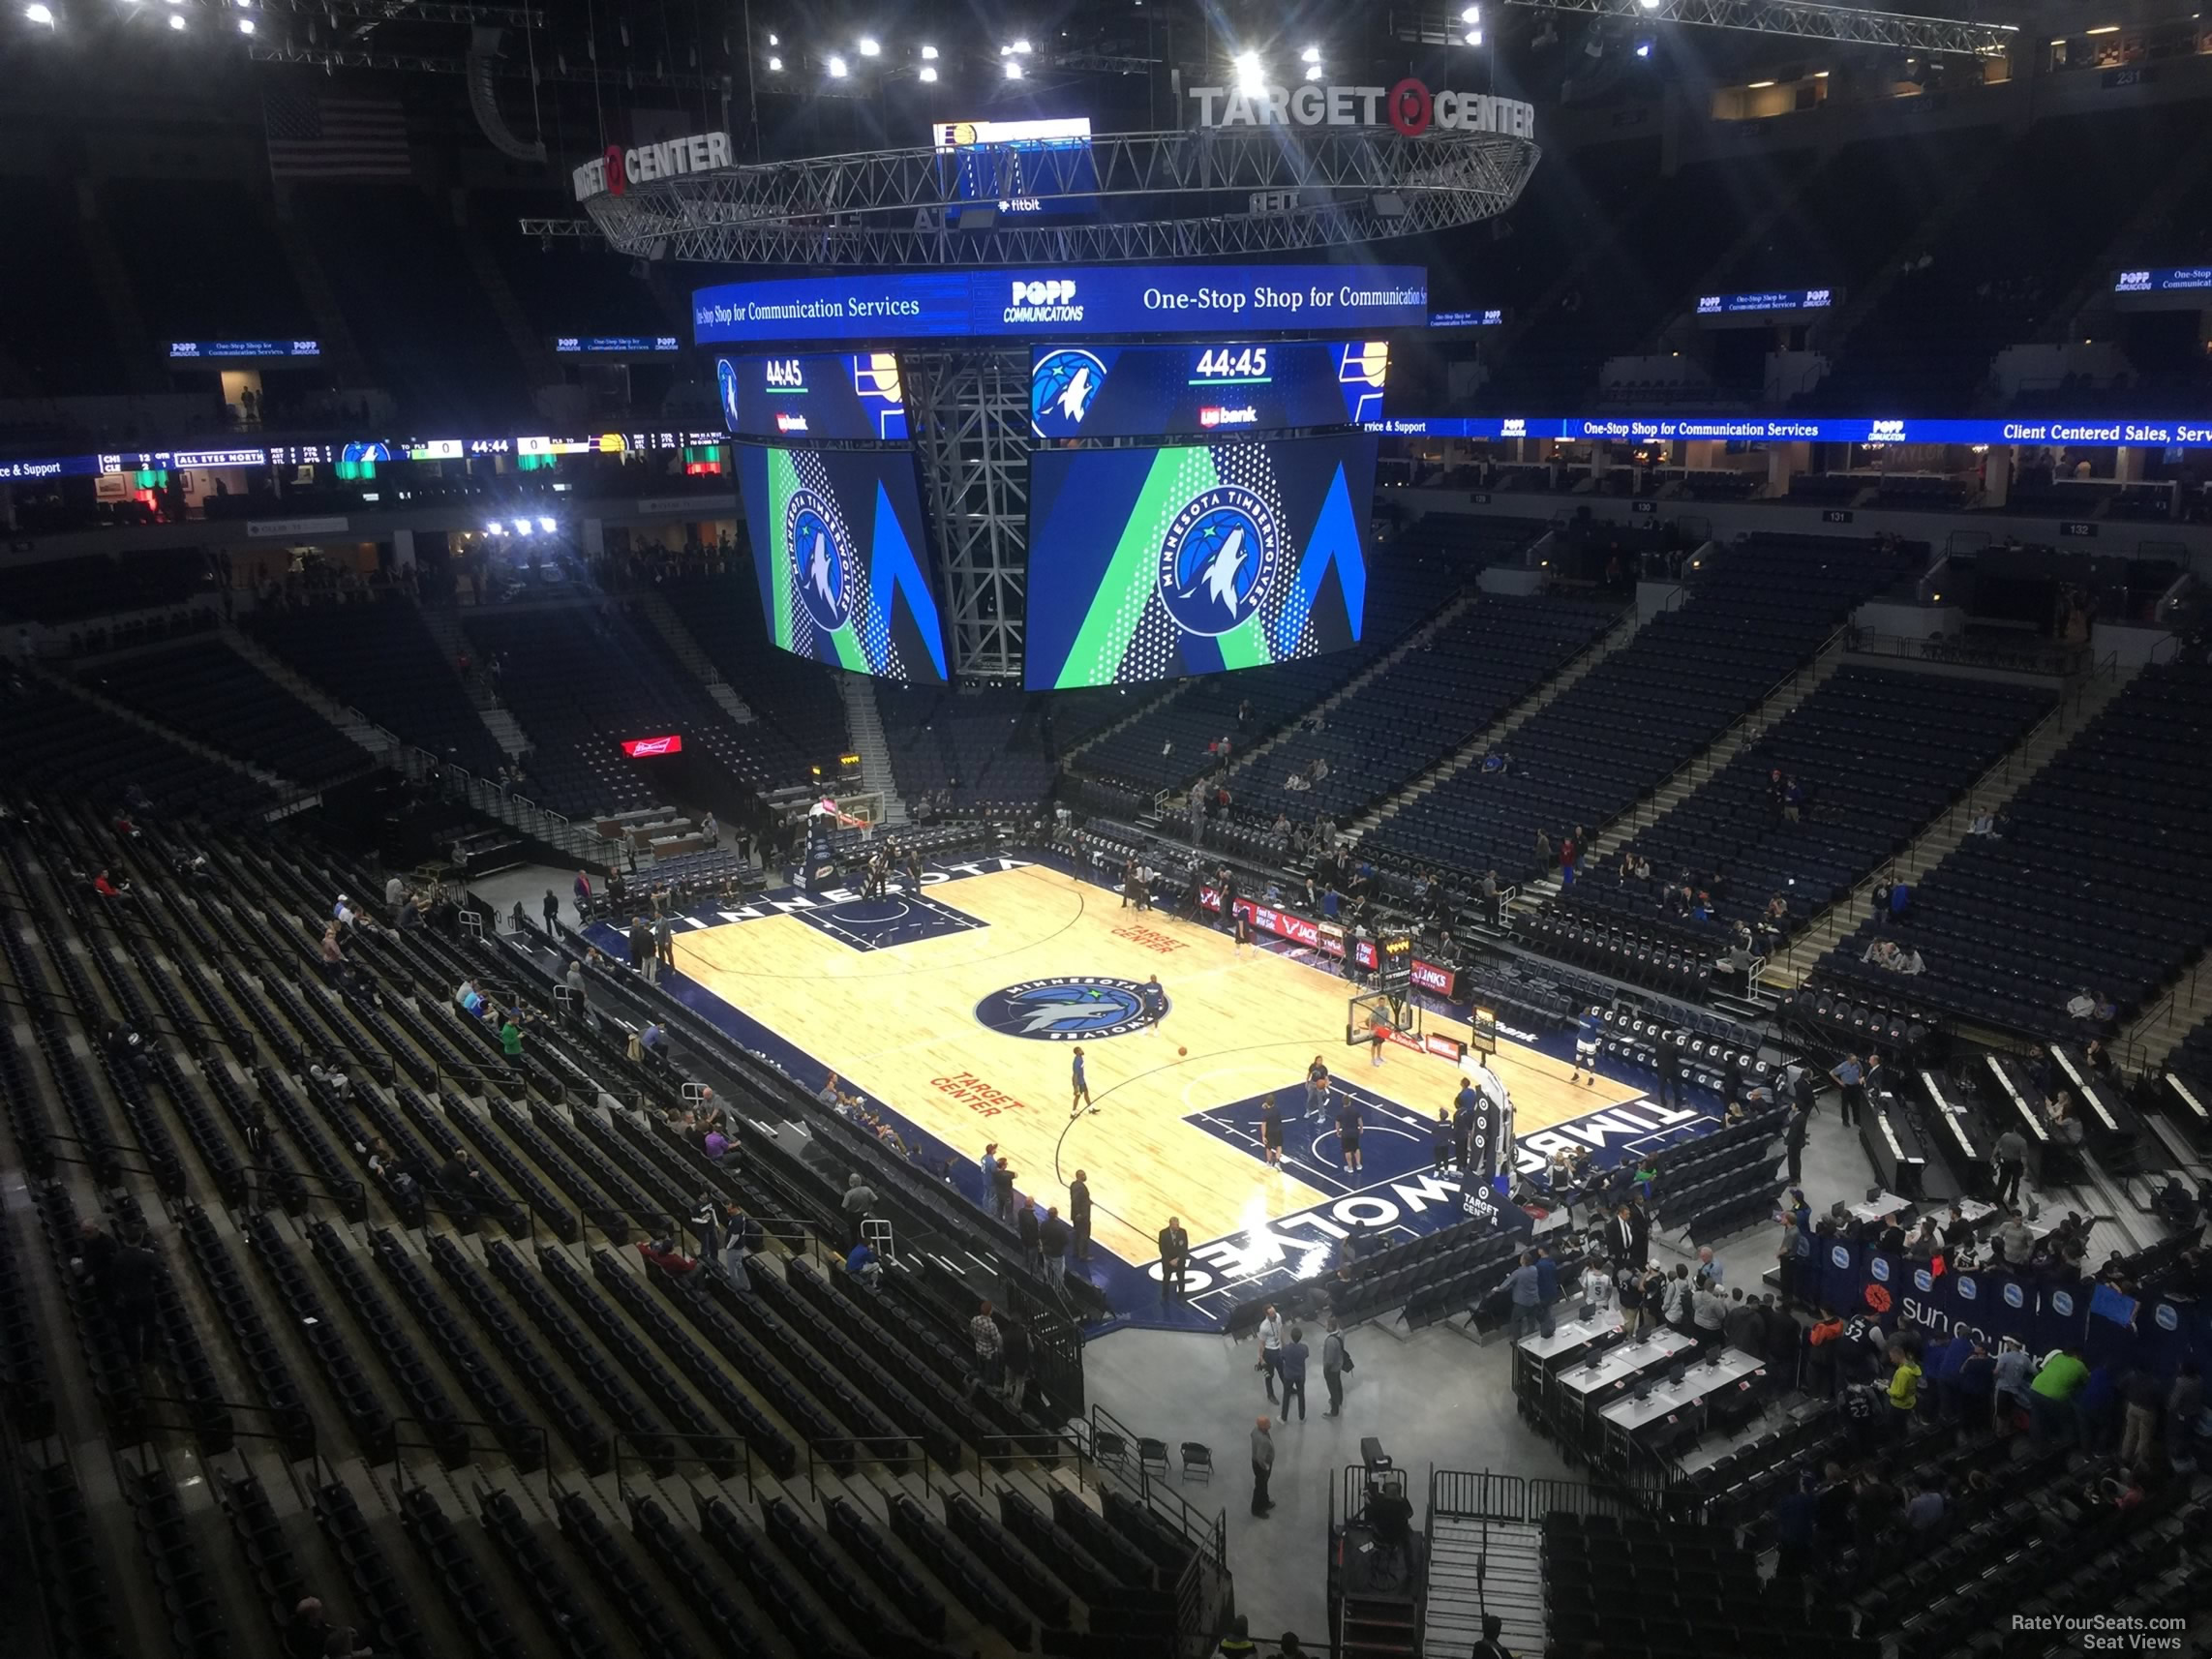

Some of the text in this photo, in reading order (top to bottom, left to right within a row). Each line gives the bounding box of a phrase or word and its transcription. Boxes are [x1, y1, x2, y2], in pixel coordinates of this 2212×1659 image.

[1189, 86, 1533, 139] TARGET CENTER
[625, 132, 733, 184] CENTER
[1011, 198, 1041, 212] fitbit
[2174, 270, 2211, 279] One-Stop
[1012, 280, 1076, 306] POPP
[1143, 287, 1246, 313] One-Stop
[1254, 287, 1303, 313] Shop
[1310, 287, 1335, 307] for
[1340, 286, 1420, 306] Communication
[714, 296, 920, 325] Shop for Communication Services
[1003, 306, 1084, 323] COMMUNICATIONS
[1196, 347, 1267, 377] 44:45
[767, 359, 803, 386] 44:45
[1364, 420, 1426, 434] rvice & Support
[1584, 422, 1819, 437] One-Stop Shop for Communication Services
[1872, 420, 1903, 433] POPP
[2003, 424, 2045, 439] Client
[2051, 425, 2120, 441] Centered
[2125, 426, 2170, 443] Sales,
[441, 442, 449, 454] 0
[471, 439, 509, 453] 44:44
[530, 439, 537, 450] 0
[13, 463, 61, 476] & Support
[1638, 502, 1651, 512] 130
[1830, 511, 1844, 522] 131
[2070, 525, 2088, 535] 132
[1162, 491, 1275, 607] MINNESOTA TIMBERWOLVES
[1111, 928, 1174, 953] CENTER
[1128, 924, 1191, 949] TARGET
[1006, 978, 1137, 995] MINNESOTA
[1591, 1006, 1599, 1016] G
[1604, 1010, 1613, 1021] G
[1618, 1015, 1627, 1026] G
[1632, 1020, 1642, 1031] G
[1647, 1025, 1656, 1036] G
[1608, 1042, 1617, 1051] G
[1677, 1035, 1685, 1045] G
[1692, 1040, 1701, 1051] G
[1622, 1047, 1630, 1056] G
[1637, 1052, 1646, 1062] G
[1709, 1045, 1718, 1056] G
[1739, 1055, 1749, 1066] G
[1756, 1061, 1766, 1071] G
[1682, 1069, 1690, 1078] G
[1698, 1074, 1707, 1083] G
[953, 1071, 1025, 1109] TARGET
[1712, 1079, 1722, 1089] G
[930, 1077, 1002, 1118] CENTER
[1464, 1192, 1500, 1217] TARGET
[1463, 1202, 1499, 1226] CENTR
[1594, 1286, 1601, 1296] 5
[1902, 1297, 1949, 1333] sun
[1844, 1325, 1863, 1342] 32
[1850, 1404, 1869, 1418] 22
